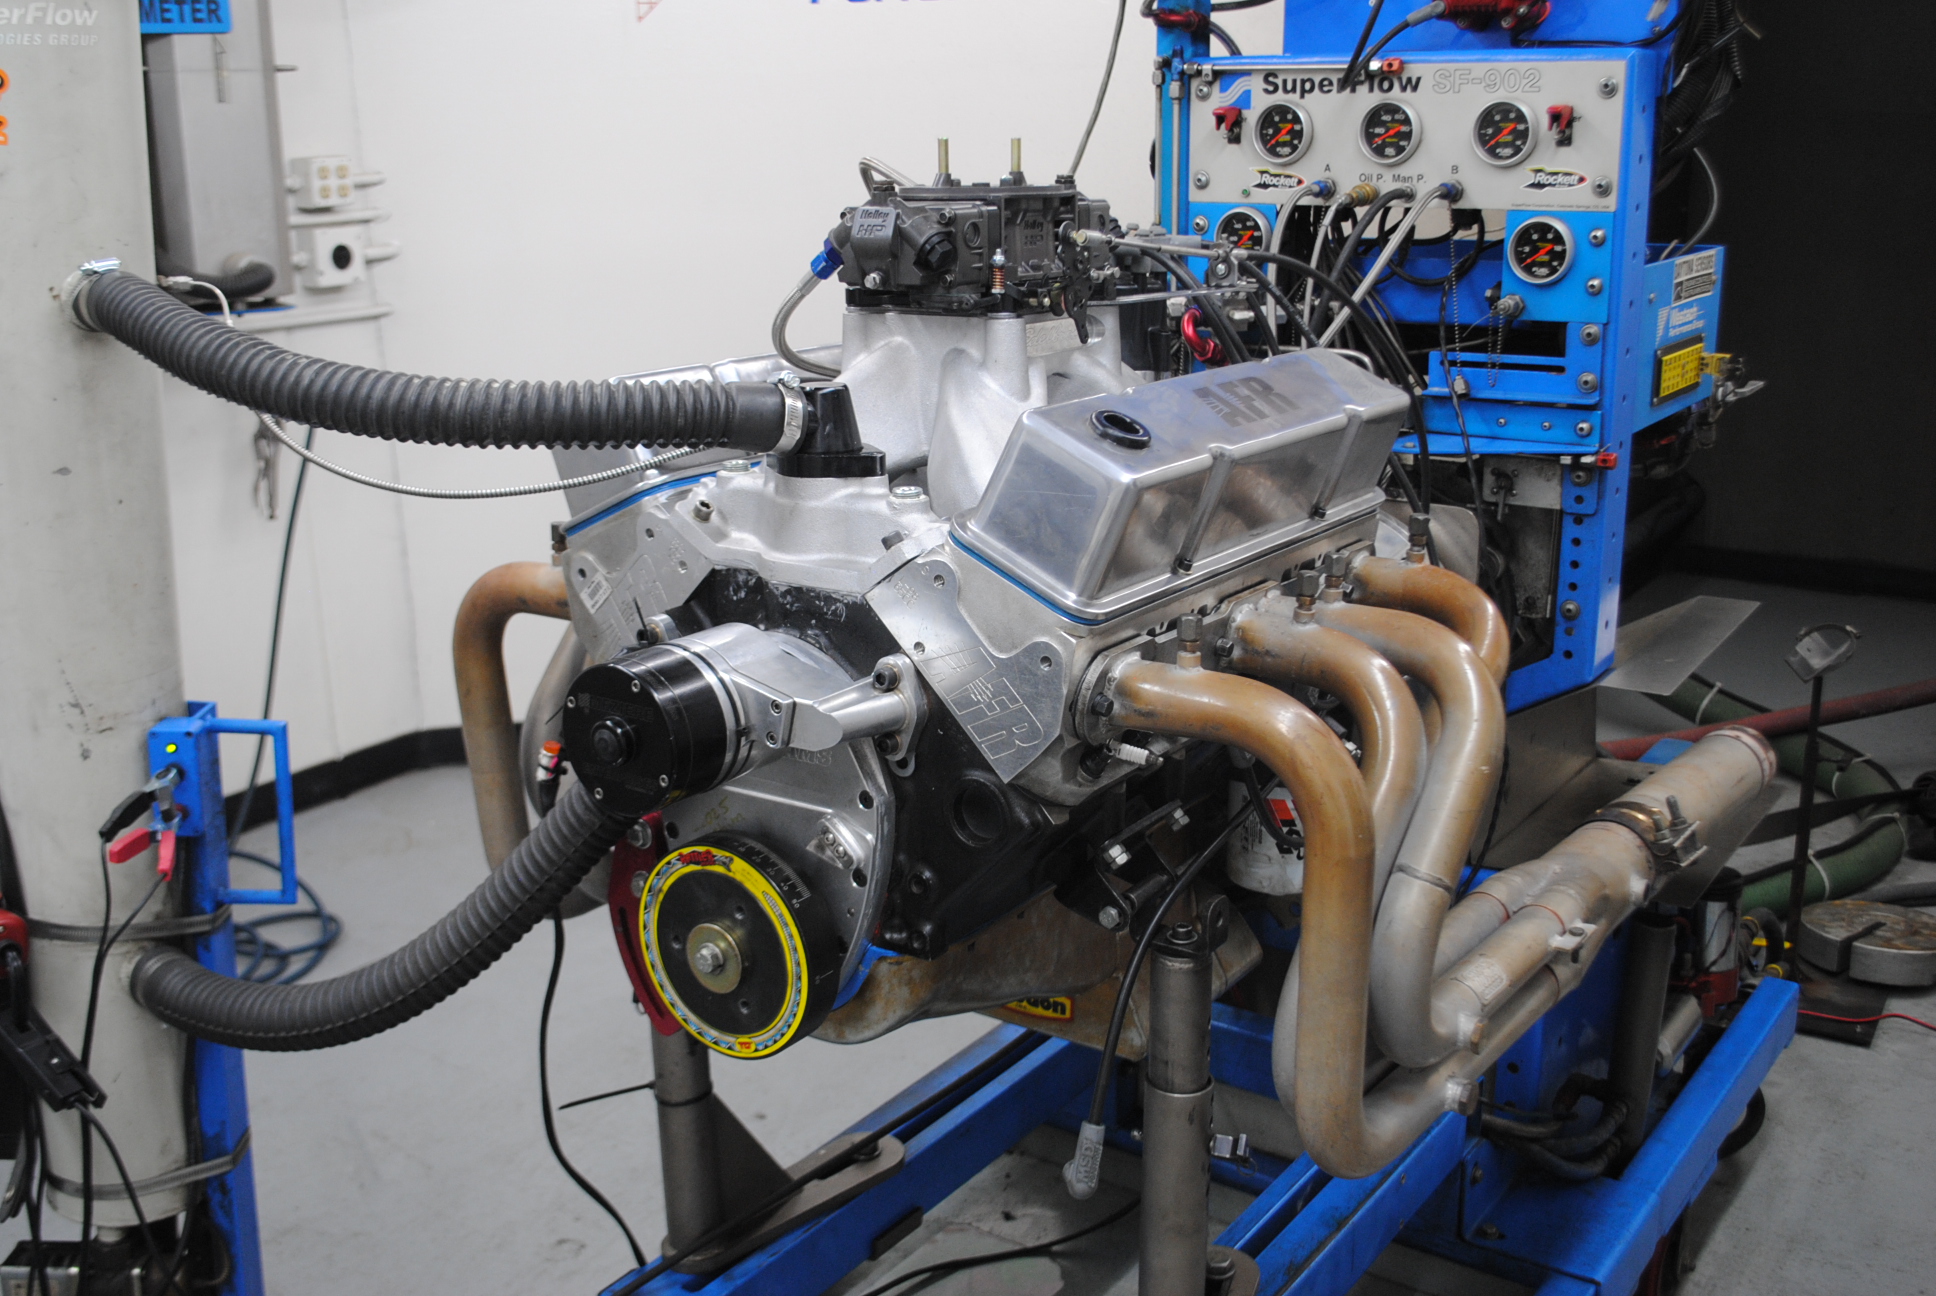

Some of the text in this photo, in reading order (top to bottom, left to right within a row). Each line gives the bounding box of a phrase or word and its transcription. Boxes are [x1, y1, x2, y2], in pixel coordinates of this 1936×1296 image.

[139, 0, 224, 23] METER
[49, 33, 98, 46] GROUP
[1432, 67, 1541, 94] SF-902
[1324, 164, 1331, 172] A
[1451, 165, 1459, 174] B
[1260, 174, 1299, 187] Rockett
[1359, 173, 1427, 184] Oil P. Man P.
[1534, 172, 1580, 185] Rockett
[859, 208, 890, 223] Holley
[856, 224, 888, 238] HP
[1023, 218, 1044, 231] Holley
